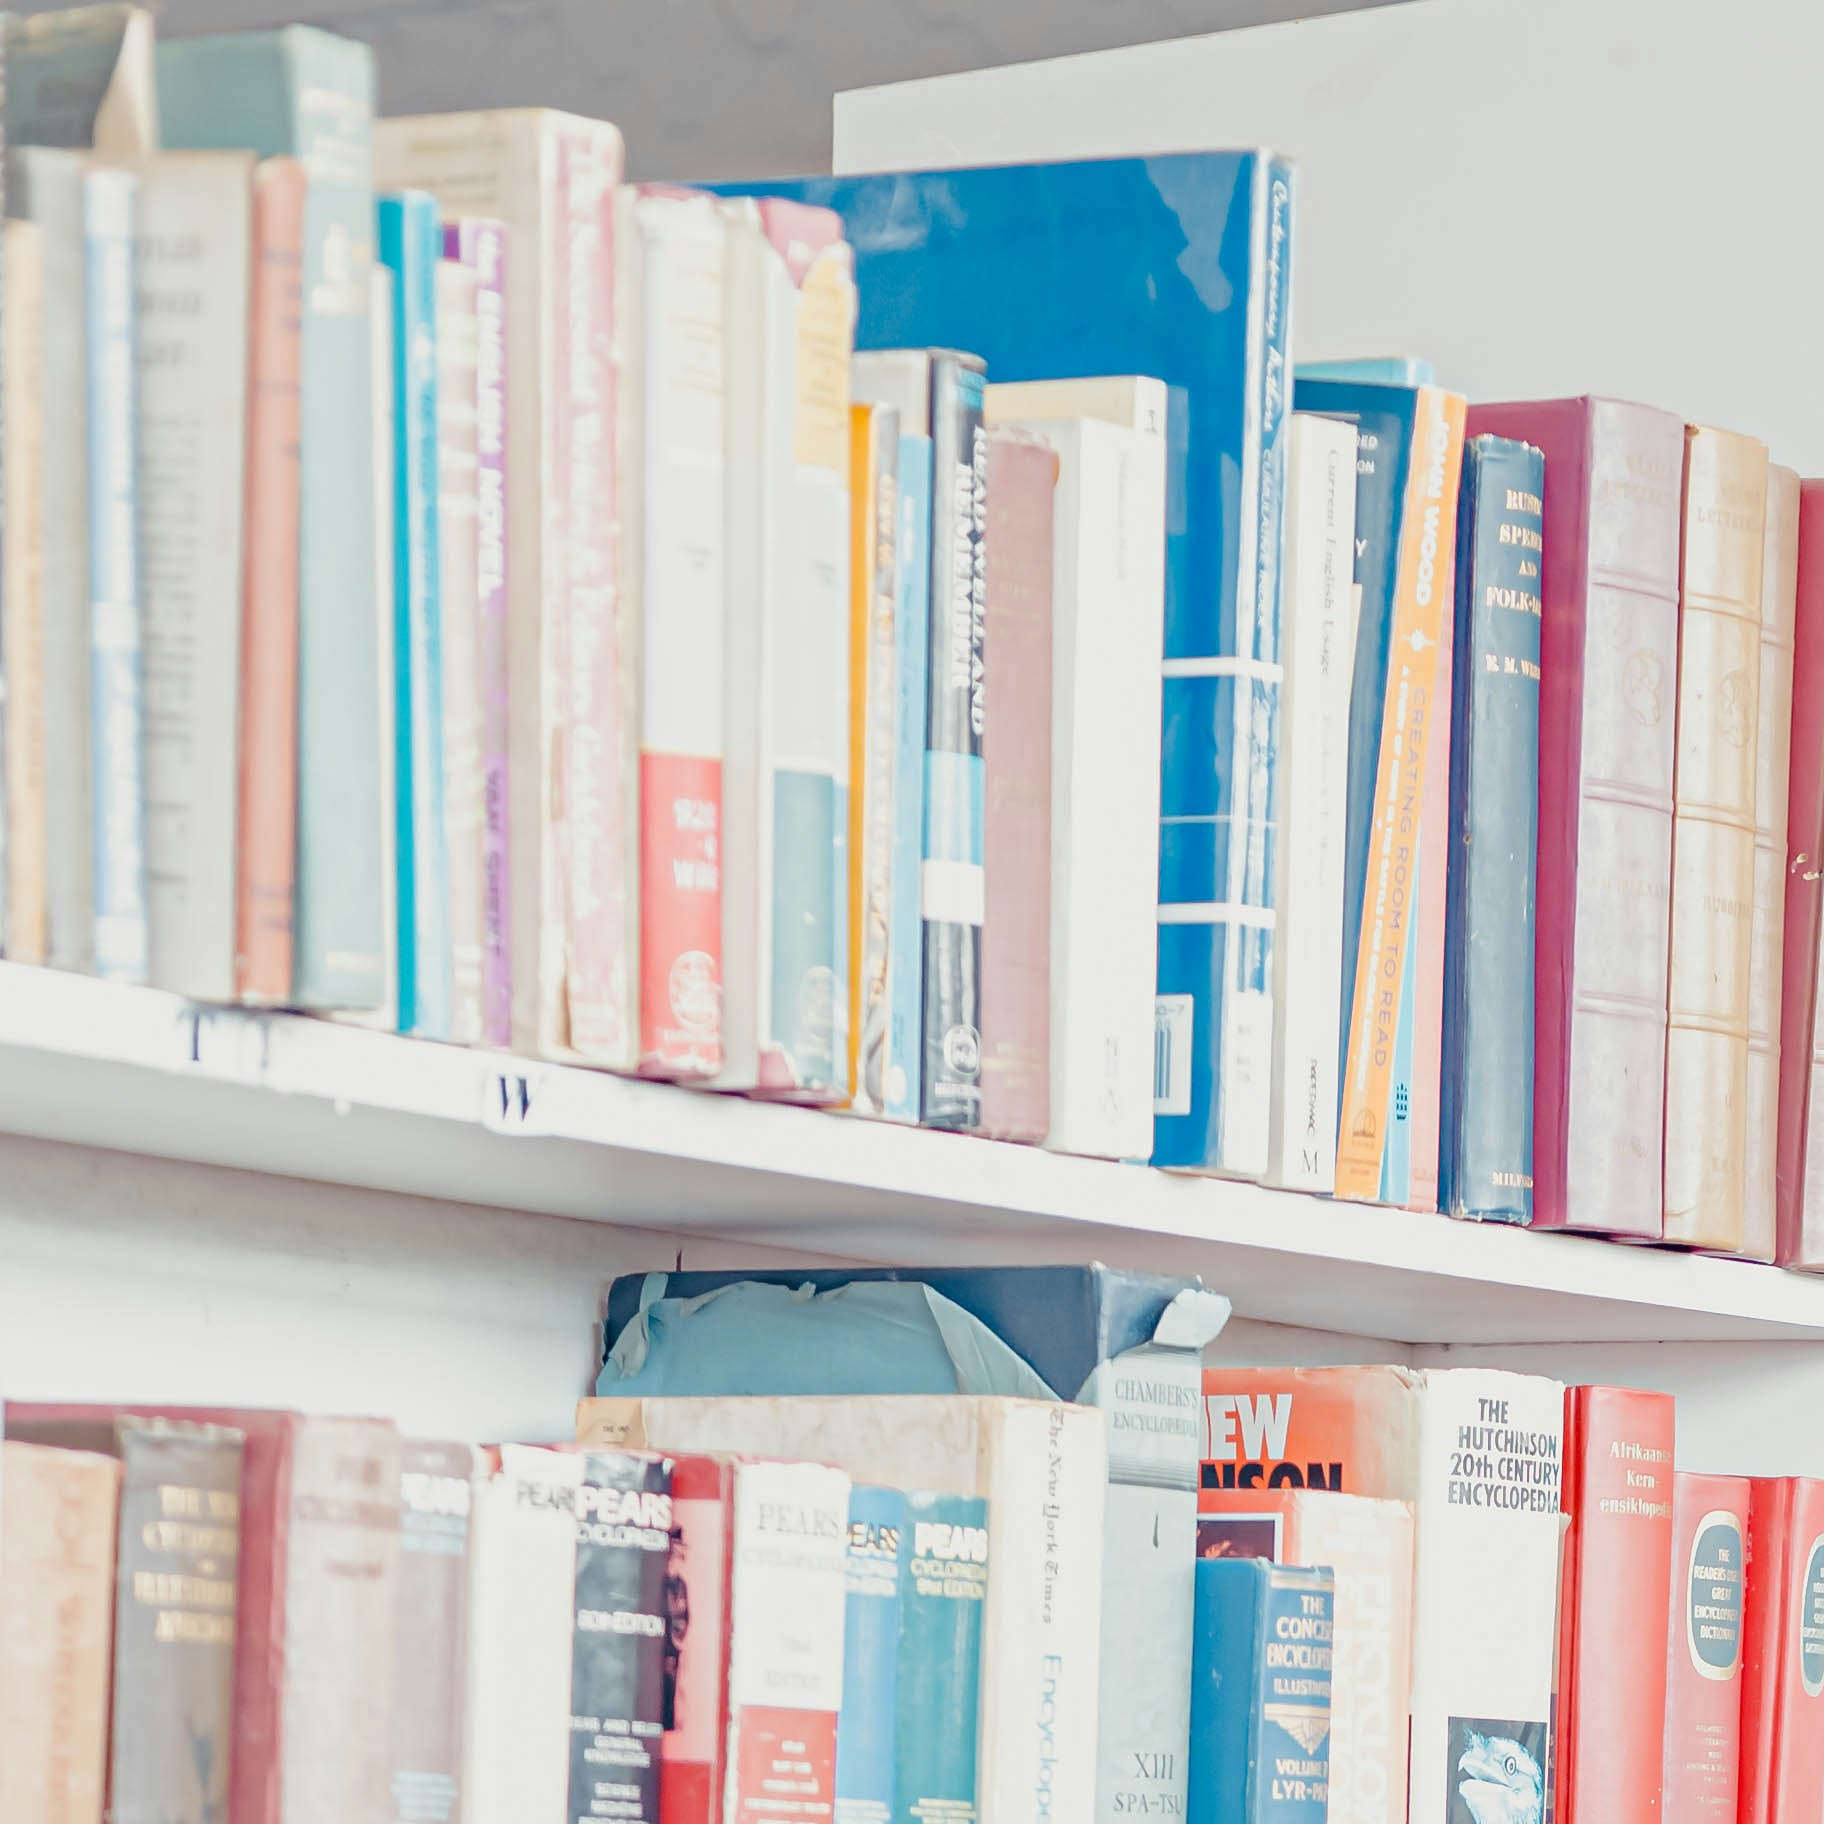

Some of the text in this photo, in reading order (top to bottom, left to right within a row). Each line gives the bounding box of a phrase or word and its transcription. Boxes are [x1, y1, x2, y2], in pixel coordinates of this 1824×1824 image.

[477, 467, 504, 599] NOVEL
[1415, 419, 1450, 607] JOHN WOOD
[971, 659, 988, 735] AND
[1398, 686, 1428, 834] CREATING
[1389, 844, 1411, 929] ROOM
[1382, 939, 1400, 980] TO
[1373, 991, 1394, 1069] READ
[1478, 1397, 1510, 1425] THE
[1457, 1425, 1558, 1459] HUTCHINSON
[1450, 1452, 1561, 1484] 20th CENTURY
[574, 1484, 674, 1531] PEARS
[1447, 1479, 1561, 1515] ENCYCLOPEDIA
[913, 1520, 989, 1564] PEARS
[1300, 1594, 1325, 1618] THE
[1133, 1752, 1174, 1781] XIII
